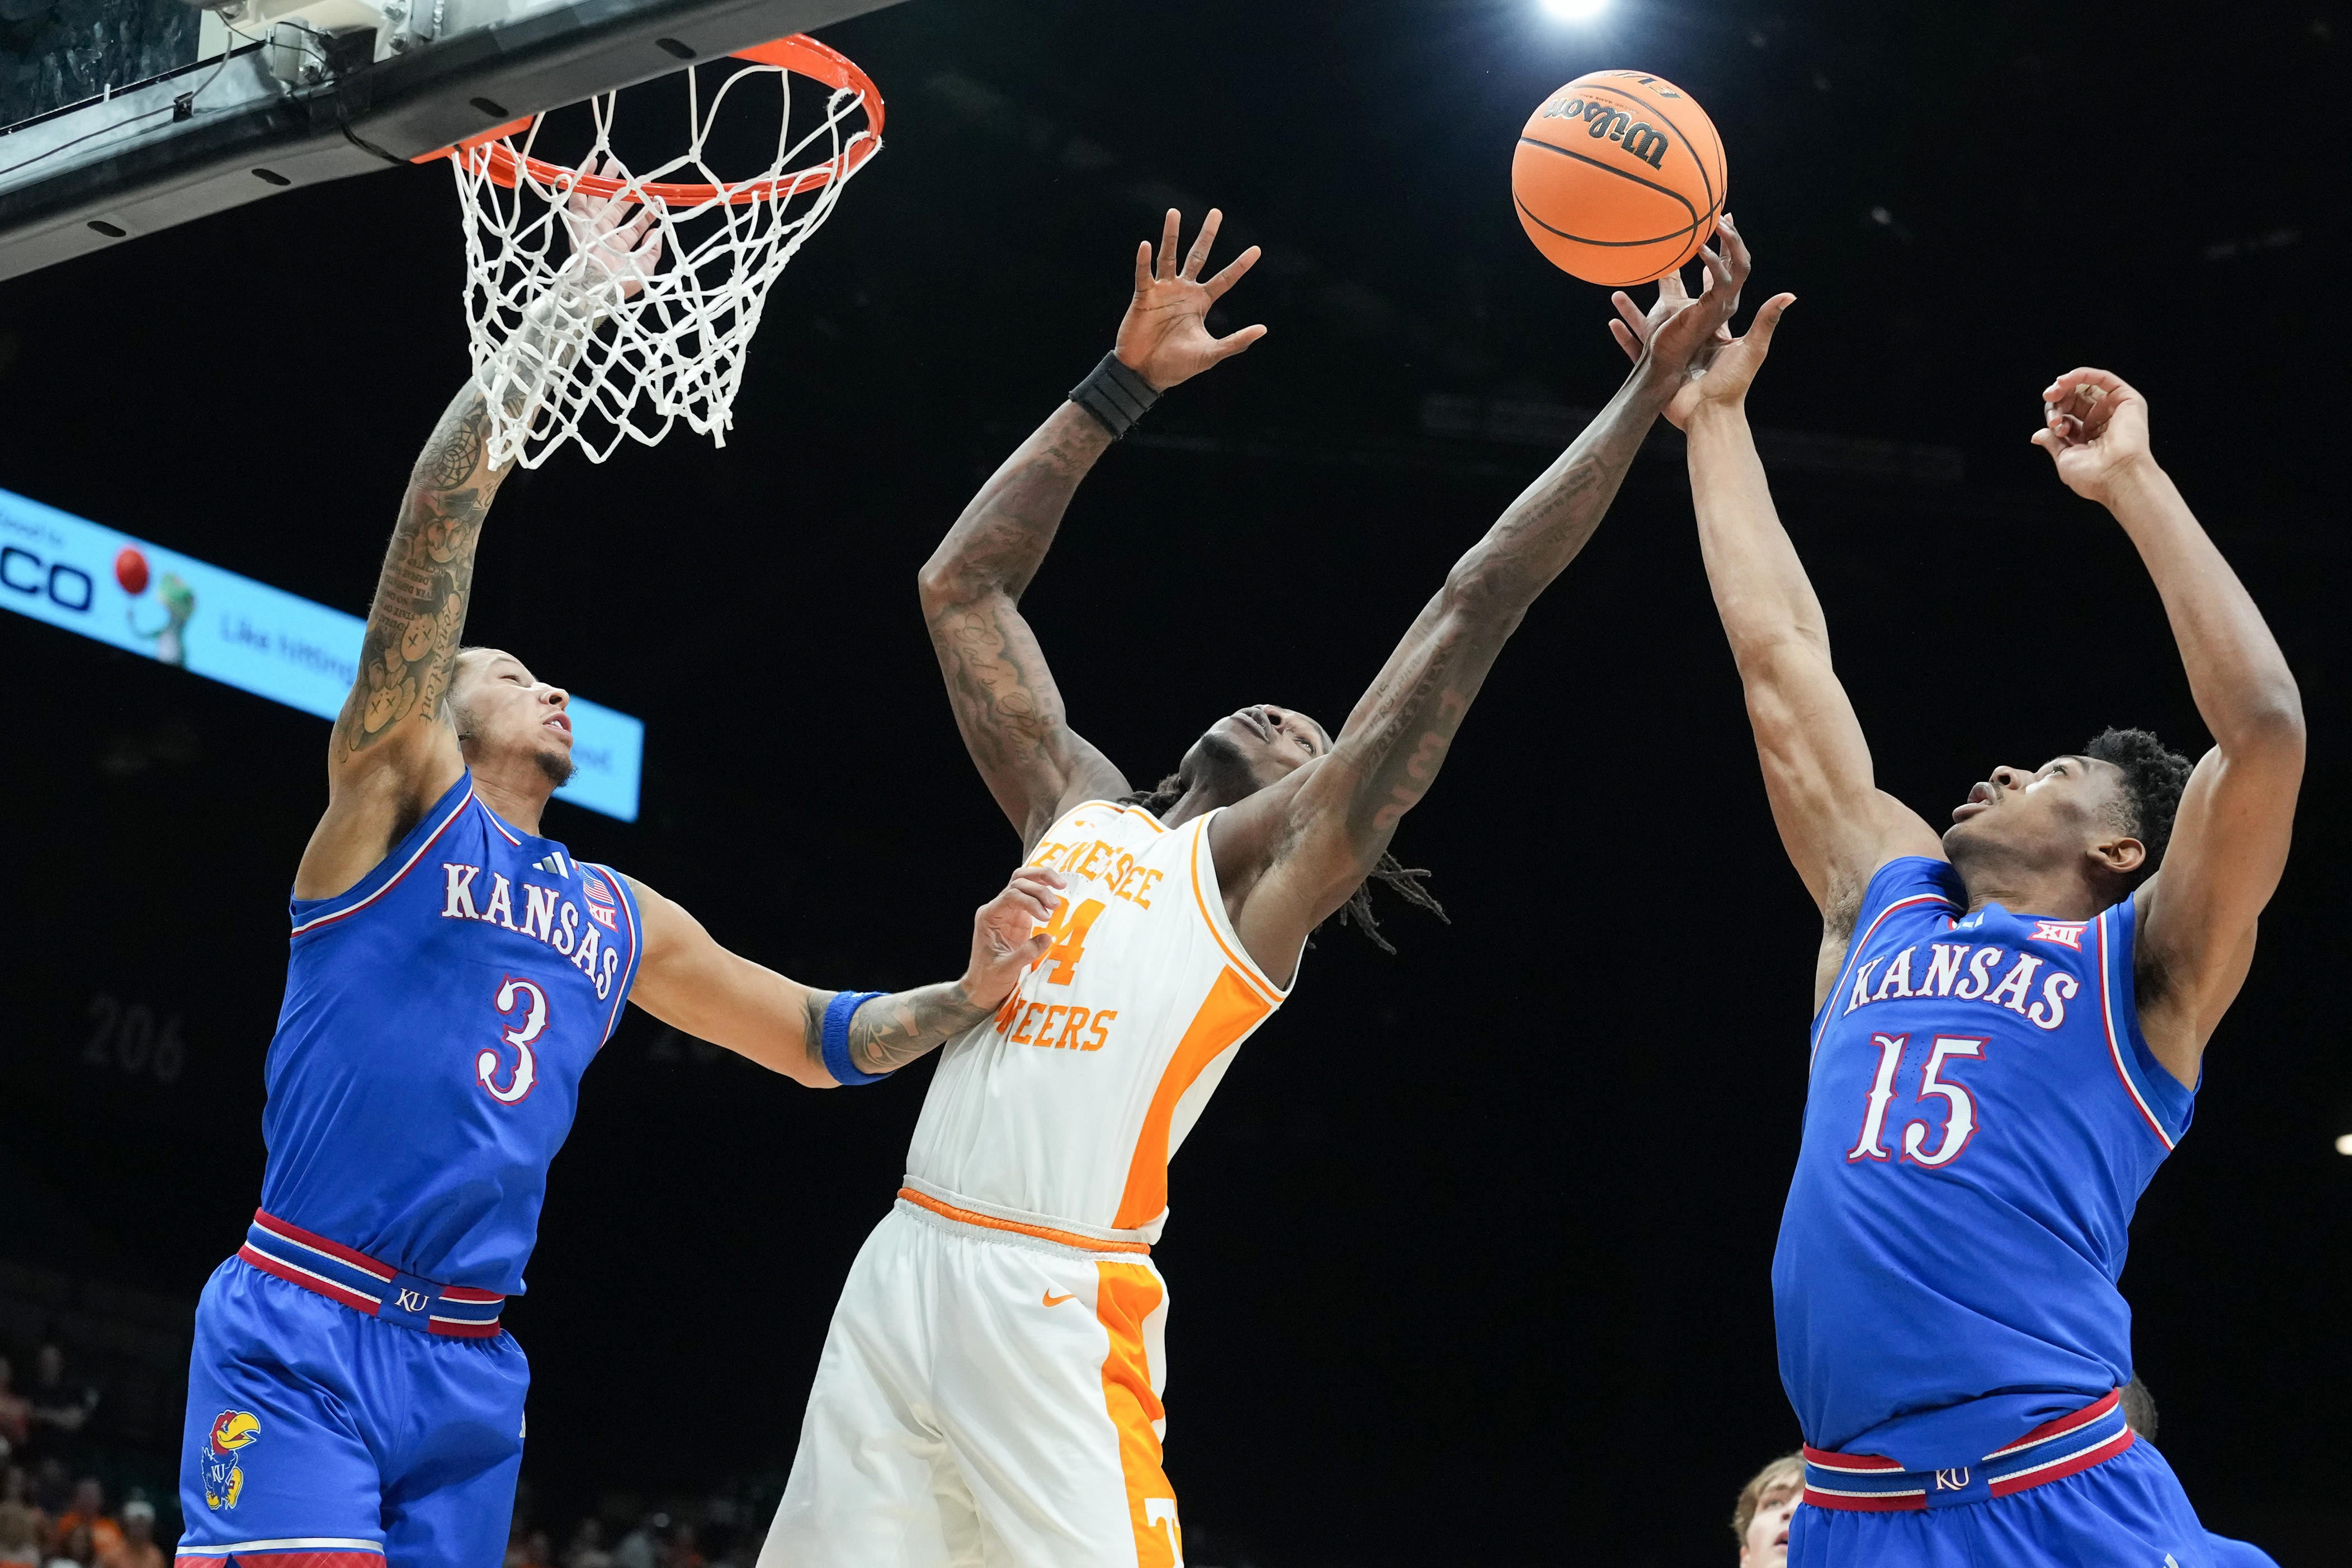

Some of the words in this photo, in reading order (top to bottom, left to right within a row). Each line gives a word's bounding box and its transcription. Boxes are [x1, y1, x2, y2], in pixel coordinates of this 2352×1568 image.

[1543, 97, 1669, 171] Wilson
[441, 863, 618, 1000] KANSAS
[2030, 922, 2085, 950] XII
[1843, 943, 2080, 1029] KANSAS
[83, 994, 185, 1083] 206
[477, 975, 549, 1105] 3
[1848, 1034, 1989, 1168] 15
[394, 1288, 429, 1312] KU
[210, 1463, 226, 1483] KU
[1936, 1466, 1970, 1491] KU
